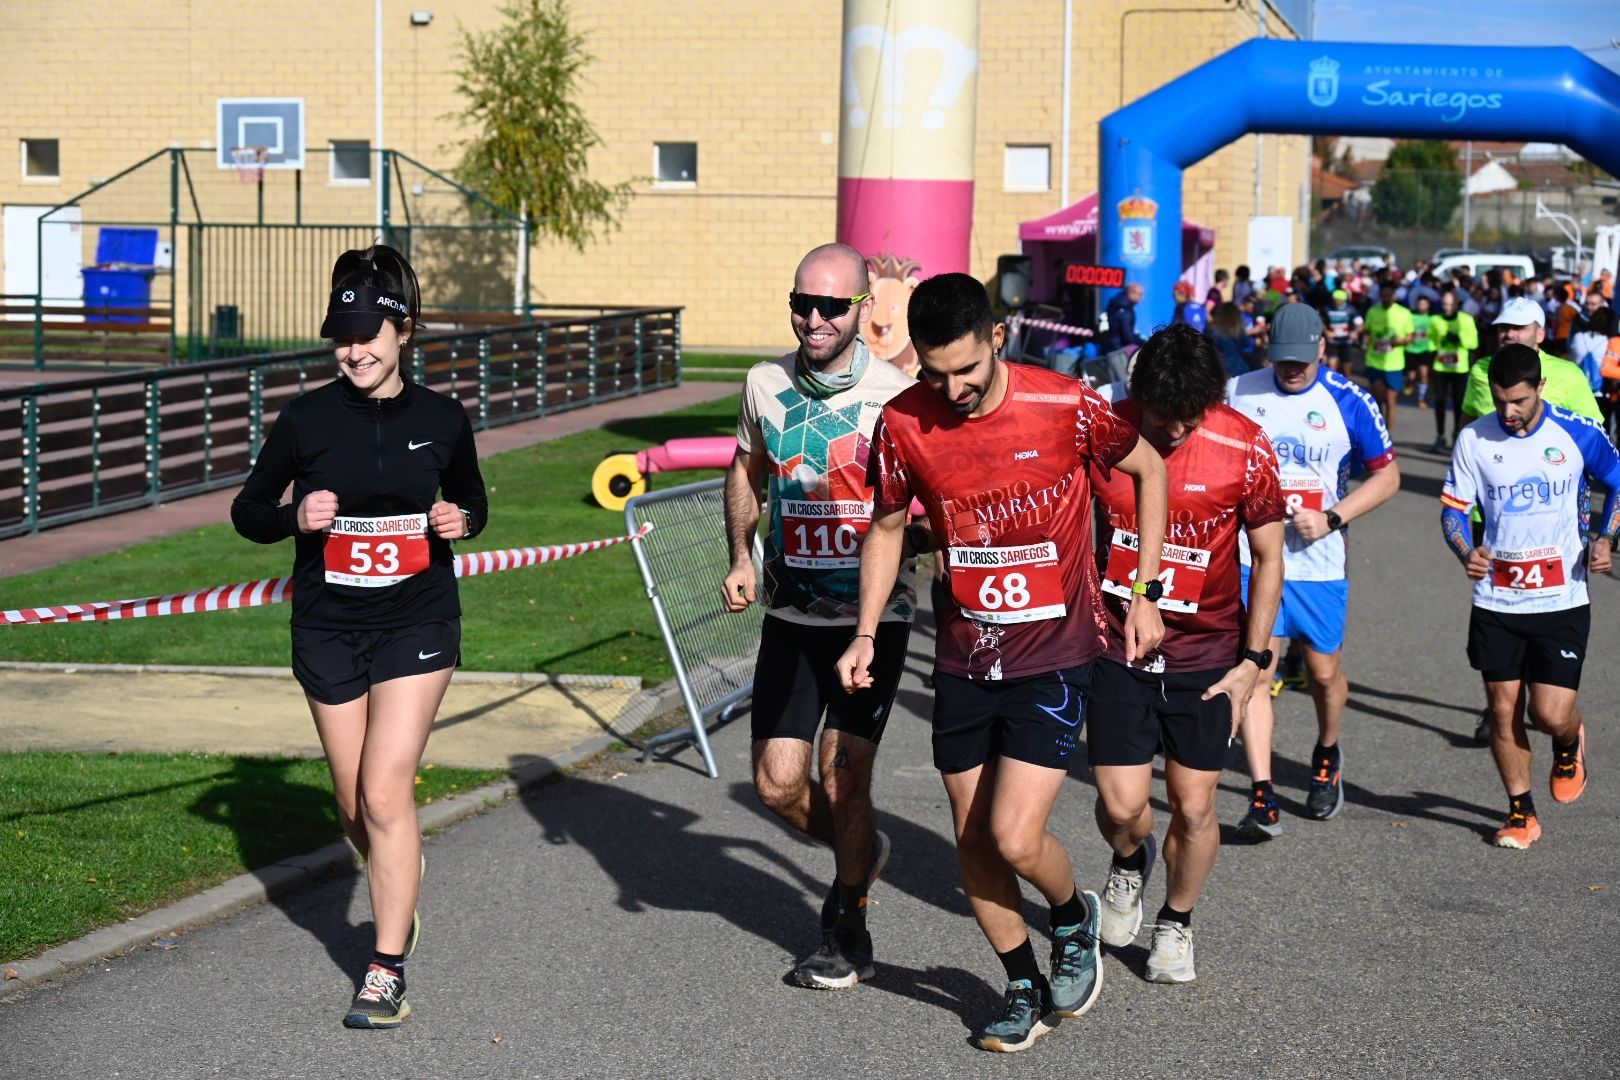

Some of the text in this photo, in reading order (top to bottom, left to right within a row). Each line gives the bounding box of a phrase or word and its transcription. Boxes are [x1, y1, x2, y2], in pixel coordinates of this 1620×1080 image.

[1364, 65, 1504, 78] AYUNTAMIENTO DE
[1362, 79, 1504, 123] Sariegos
[1014, 449, 1039, 461] HOKA
[1272, 441, 1331, 467] egui
[954, 480, 1031, 513] MEDIO
[1184, 484, 1206, 493] HOKA
[1487, 473, 1572, 503] arregui
[787, 502, 865, 516] VII CROSS SARIEGOS
[1121, 509, 1194, 528] MIO
[344, 520, 374, 533] CROSS
[376, 518, 421, 533] SARIEGOS
[795, 524, 858, 556] 110
[349, 541, 400, 575] 53
[957, 546, 1050, 564] VII CROSS SARIEGOS
[1503, 551, 1524, 560] CROSS
[1525, 546, 1557, 560] SARIEGOS
[1509, 563, 1545, 589] 24
[979, 572, 1031, 610] 68
